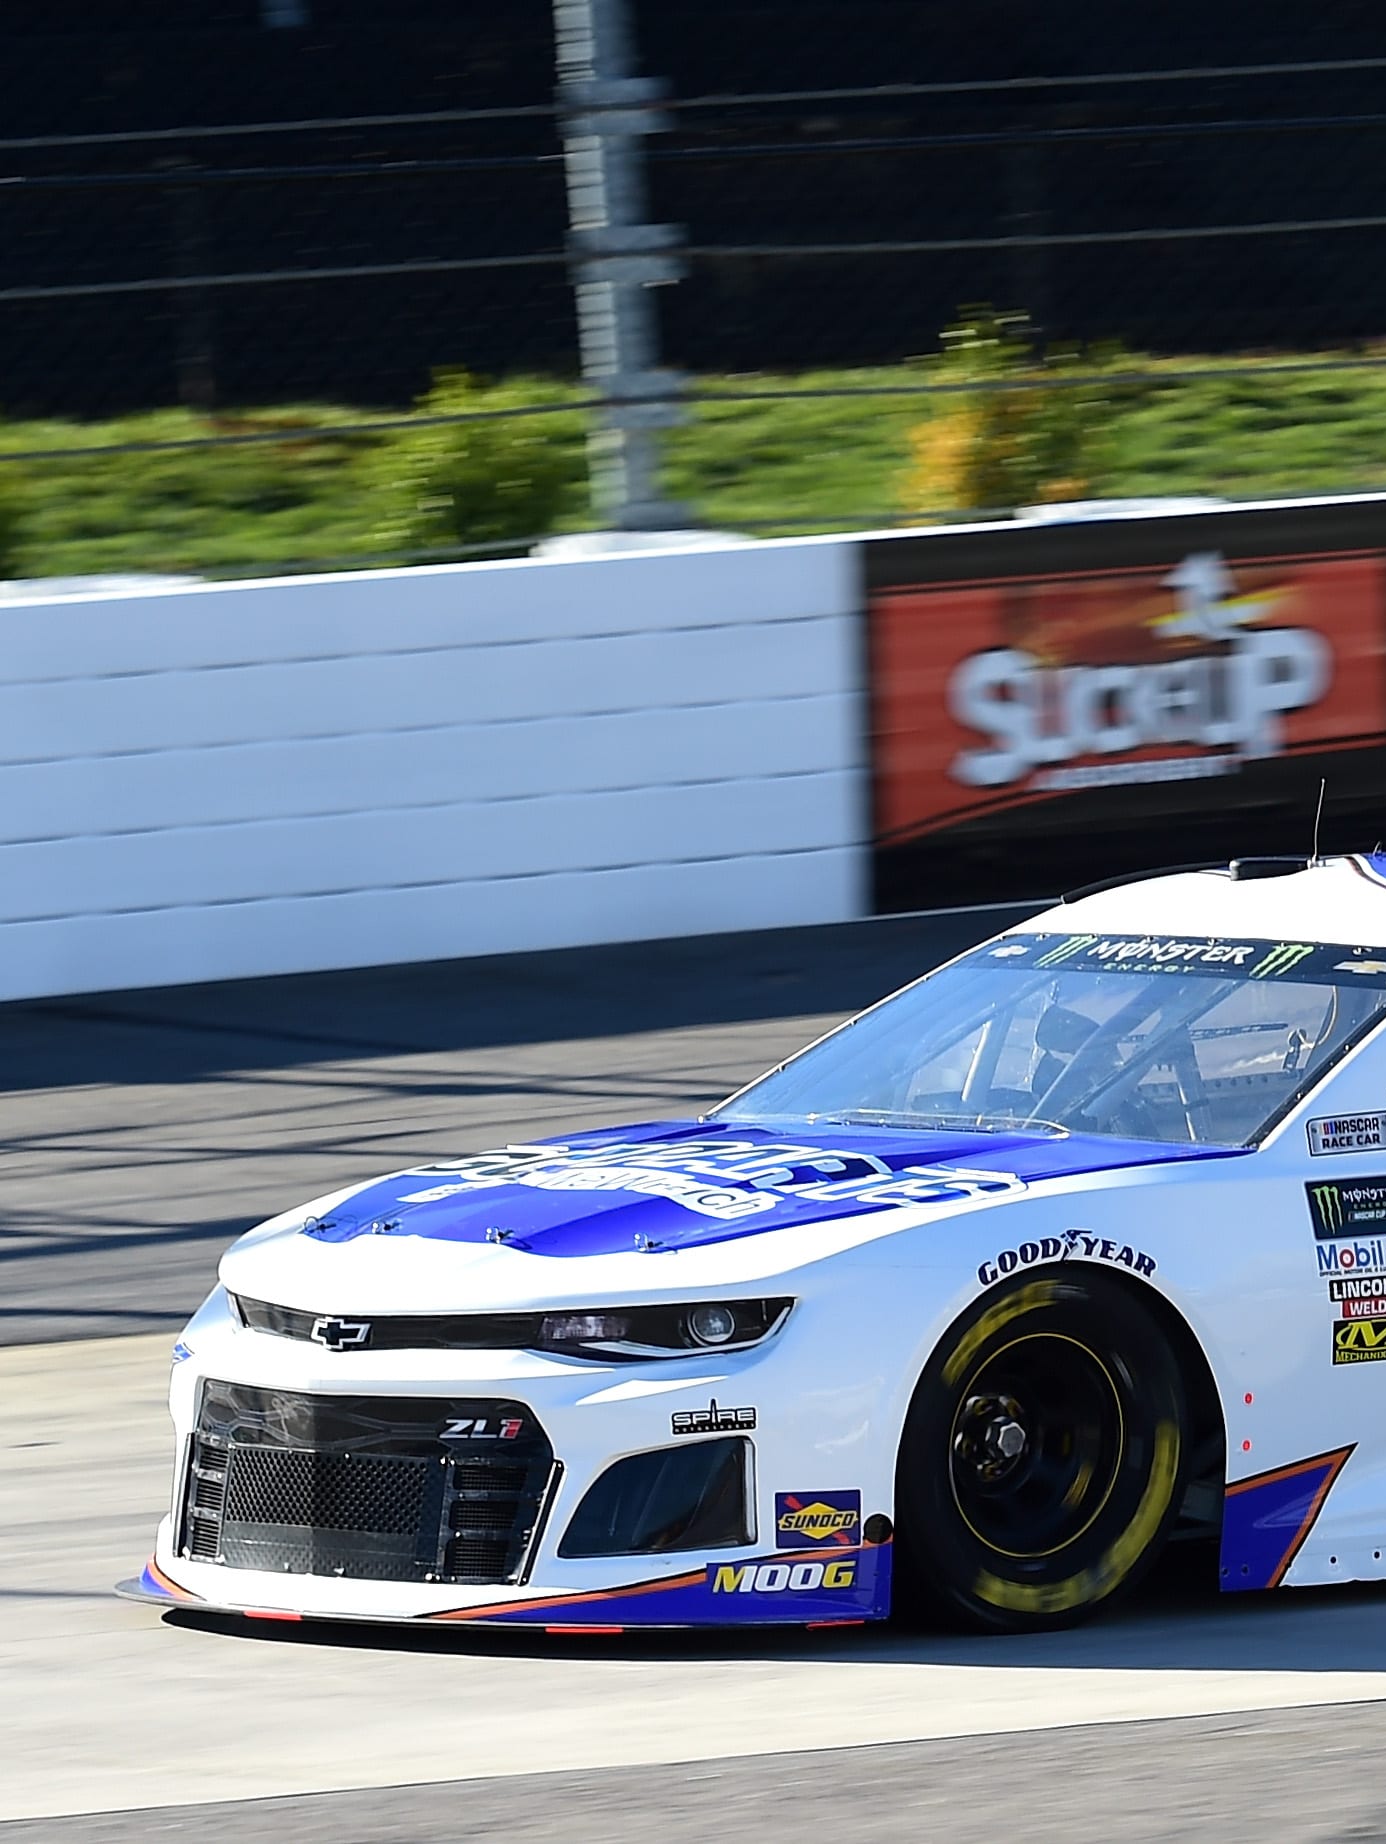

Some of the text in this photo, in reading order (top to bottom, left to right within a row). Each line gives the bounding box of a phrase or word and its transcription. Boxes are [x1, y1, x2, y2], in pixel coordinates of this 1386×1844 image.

[1104, 963, 1195, 973] ENERGY
[1335, 1118, 1380, 1133] NASCAR
[1321, 1131, 1381, 1149] RACE CAR
[977, 1229, 1157, 1286] GOODYEAR
[1317, 1240, 1384, 1270] Mobil
[673, 1403, 755, 1426] SPIRE
[782, 1513, 855, 1529] SUNOCO
[712, 1561, 856, 1593] MOOG
